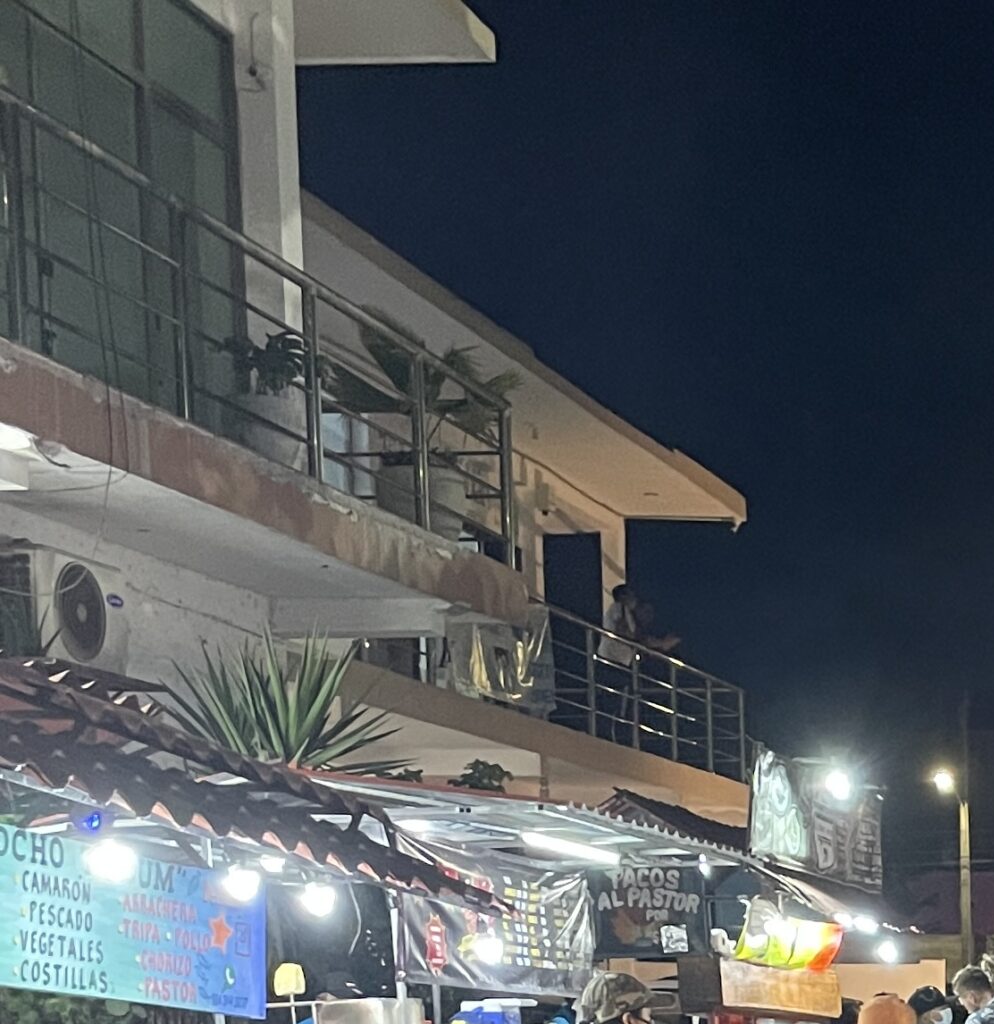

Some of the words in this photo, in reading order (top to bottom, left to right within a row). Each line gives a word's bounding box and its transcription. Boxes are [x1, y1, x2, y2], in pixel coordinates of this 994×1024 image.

[598, 890, 624, 911] AL
[627, 887, 700, 914] PASTOR
[29, 900, 93, 932] PESCADO
[123, 918, 160, 944] TRIPA
[20, 929, 104, 965] VEGETALES
[20, 959, 109, 994] COSTILLAS
[140, 949, 191, 977] CHORIZO
[144, 976, 198, 1004] PASTOR
